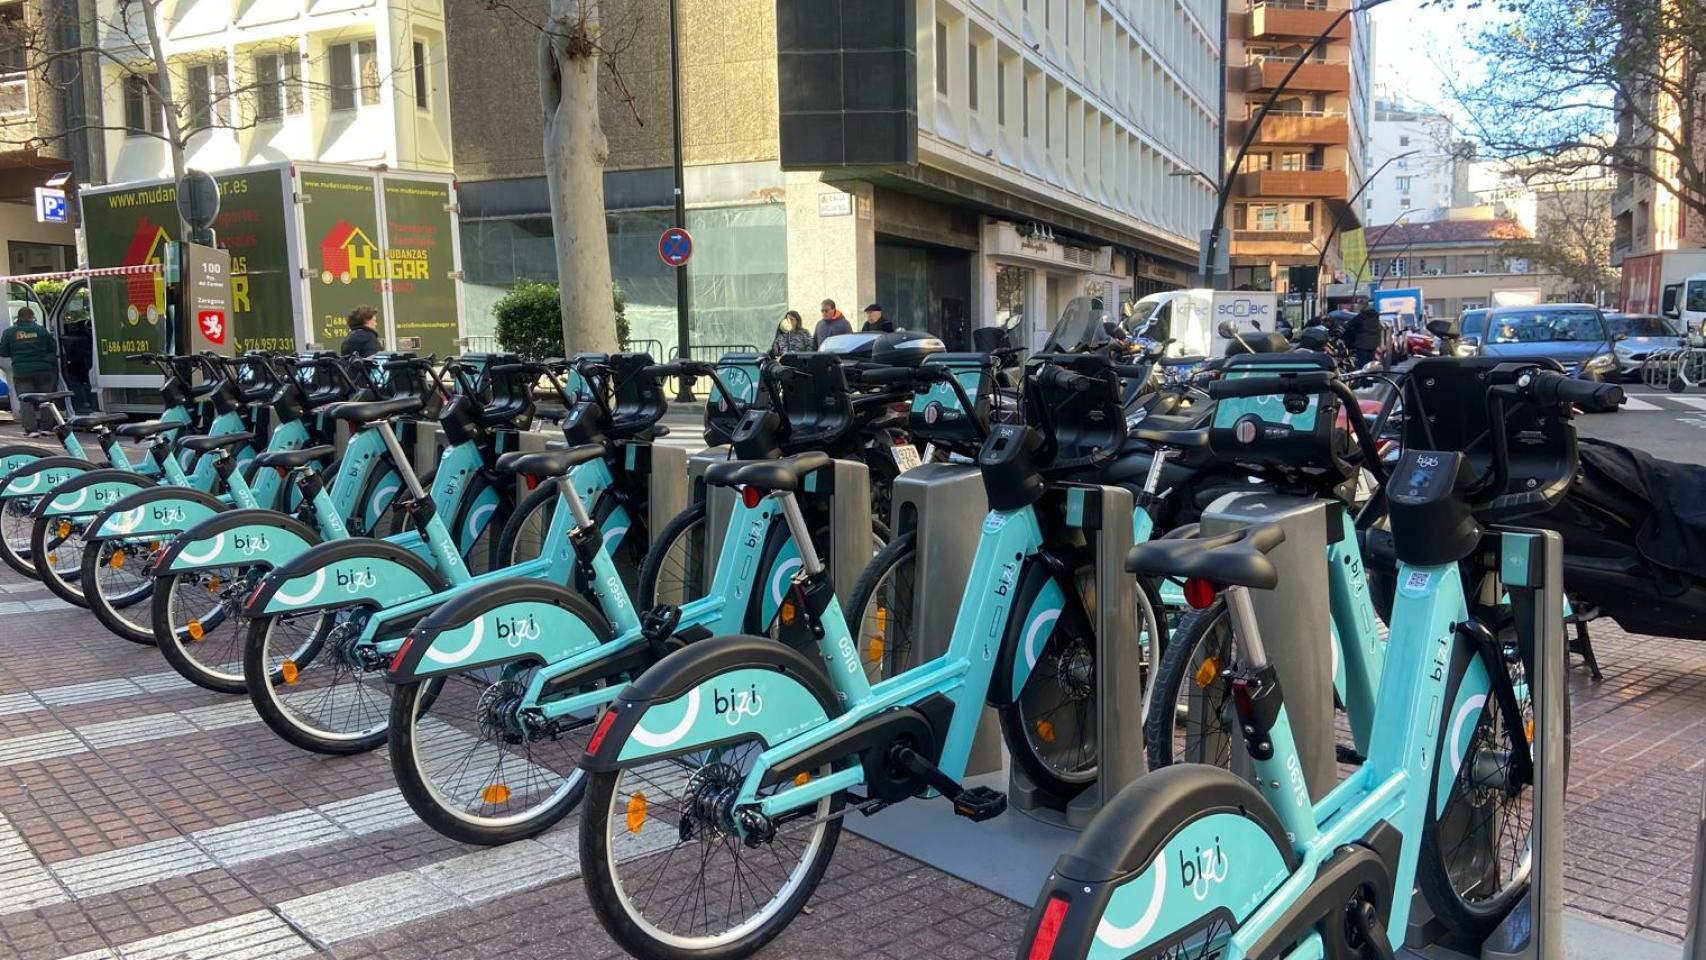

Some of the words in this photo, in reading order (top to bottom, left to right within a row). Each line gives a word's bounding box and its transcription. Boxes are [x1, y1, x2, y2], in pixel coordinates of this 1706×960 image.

[44, 197, 58, 215] P
[201, 263, 221, 273] 100
[348, 244, 430, 279] HOGAR
[108, 341, 121, 352] 686
[122, 341, 135, 352] 603
[136, 340, 149, 351] 281
[244, 338, 260, 351] 976
[261, 338, 277, 350] 957
[278, 338, 295, 350] 331
[1416, 454, 1439, 467] bizi
[95, 488, 124, 504] bizi
[154, 506, 186, 525] bizi
[234, 533, 270, 555] bizi
[745, 520, 764, 548] bizi
[337, 567, 377, 593] bizi
[607, 577, 626, 608] 0956
[993, 562, 1017, 596] bizi
[496, 614, 541, 647] bizi
[838, 637, 857, 673] 0910
[1429, 636, 1450, 682] bizi
[714, 684, 763, 726] bizi
[1287, 754, 1305, 807] 0675
[1179, 836, 1229, 900] bizi
